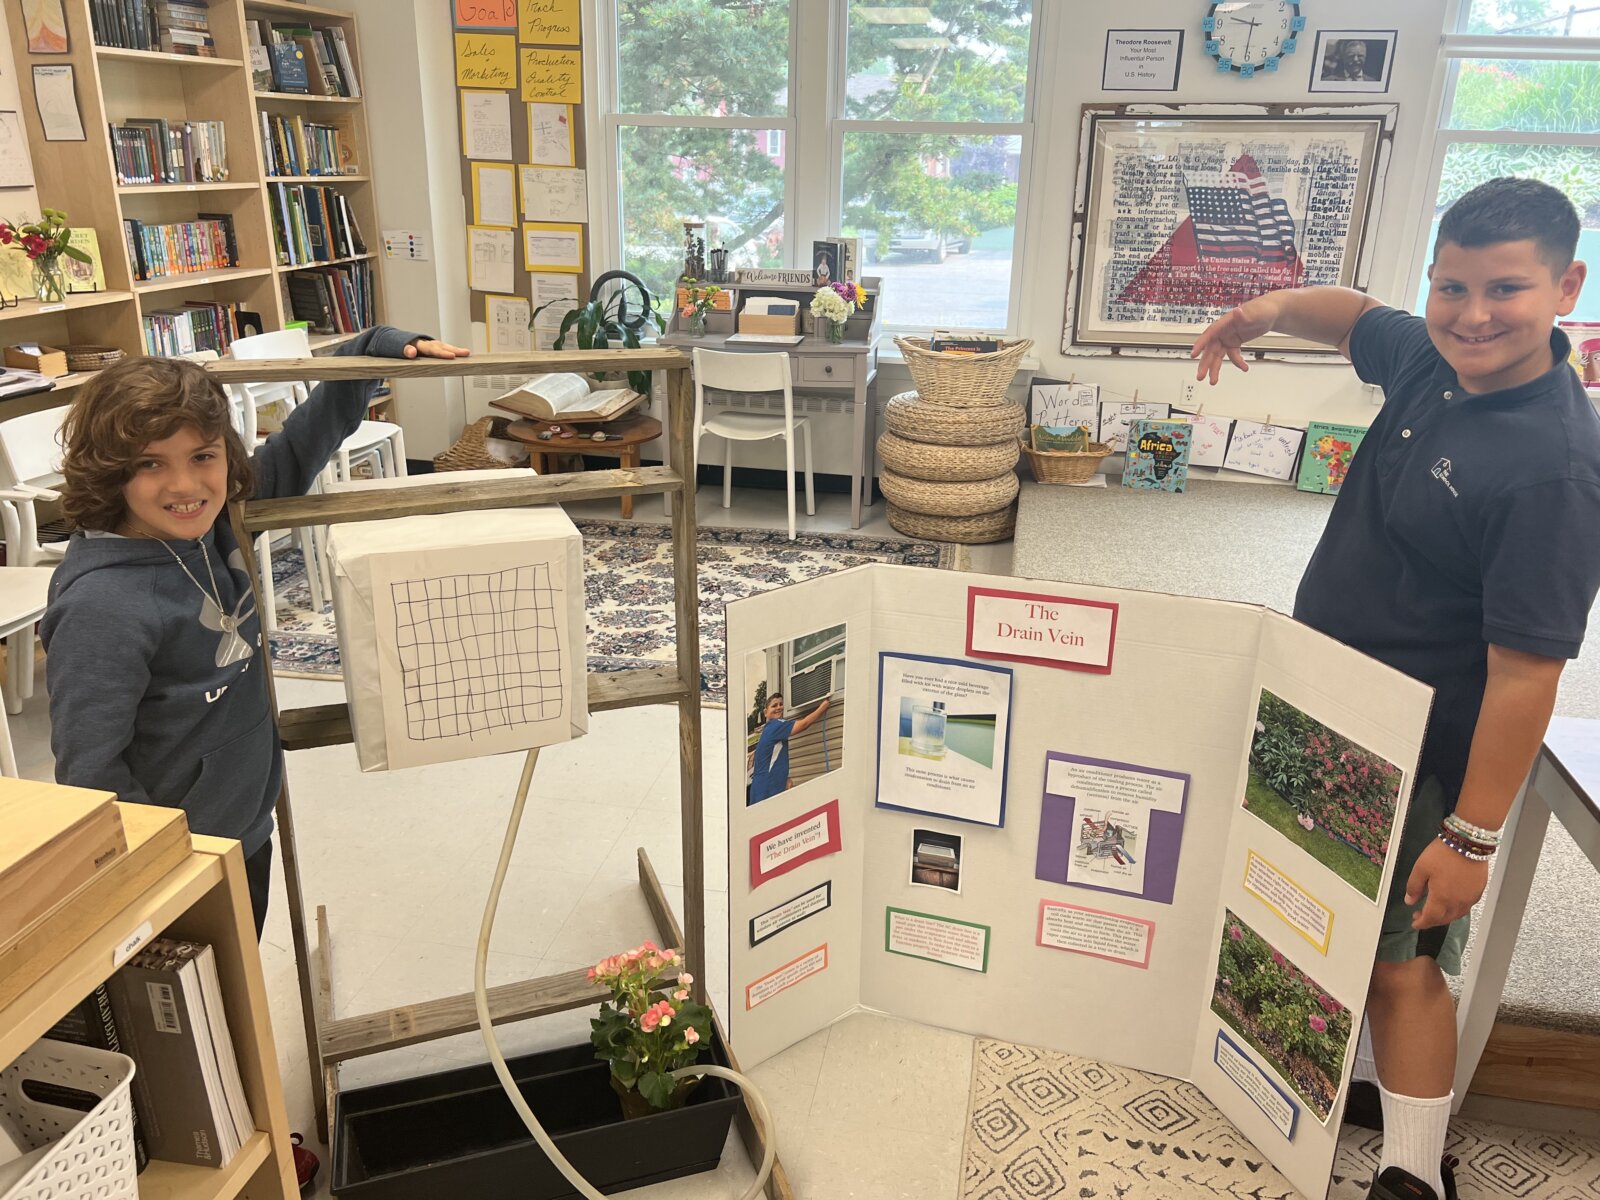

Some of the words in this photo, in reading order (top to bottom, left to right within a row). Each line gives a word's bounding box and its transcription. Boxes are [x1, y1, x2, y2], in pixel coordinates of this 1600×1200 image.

[1278, 1, 1285, 12] 2
[528, 17, 570, 38] Progress
[1203, 21, 1213, 29] 45
[1217, 18, 1223, 29] 9
[1281, 18, 1288, 29] 3
[1220, 35, 1226, 46] 8
[1273, 36, 1279, 46] 4
[1283, 42, 1294, 50] 20
[461, 40, 496, 58] Sales
[1206, 43, 1216, 52] 40
[1229, 47, 1235, 58] 7
[1261, 47, 1267, 58] 5
[526, 51, 576, 66] Production
[1244, 51, 1250, 62] 6
[1218, 61, 1230, 69] 35
[1265, 60, 1276, 68] 25
[461, 67, 511, 85] Marketing
[1137, 71, 1156, 79] History
[1241, 67, 1254, 75] 30
[526, 72, 575, 89] Quality
[529, 88, 567, 98] Control
[1155, 201, 1169, 209] give
[1138, 207, 1178, 216] information,
[1171, 265, 1197, 273] support
[746, 269, 778, 282] Welcome
[778, 272, 811, 284] FRIENDS
[1035, 409, 1093, 428] Patterns
[1140, 439, 1173, 452] Africa
[1025, 603, 1059, 621] The
[996, 622, 1043, 642] Drain
[1048, 628, 1084, 647] Vein
[766, 843, 776, 852] We
[777, 834, 793, 846] have
[794, 821, 820, 839] invented
[766, 849, 781, 861] "The
[783, 842, 801, 854] Drain
[125, 936, 141, 952] chalk
[97, 993, 112, 1023] READ
